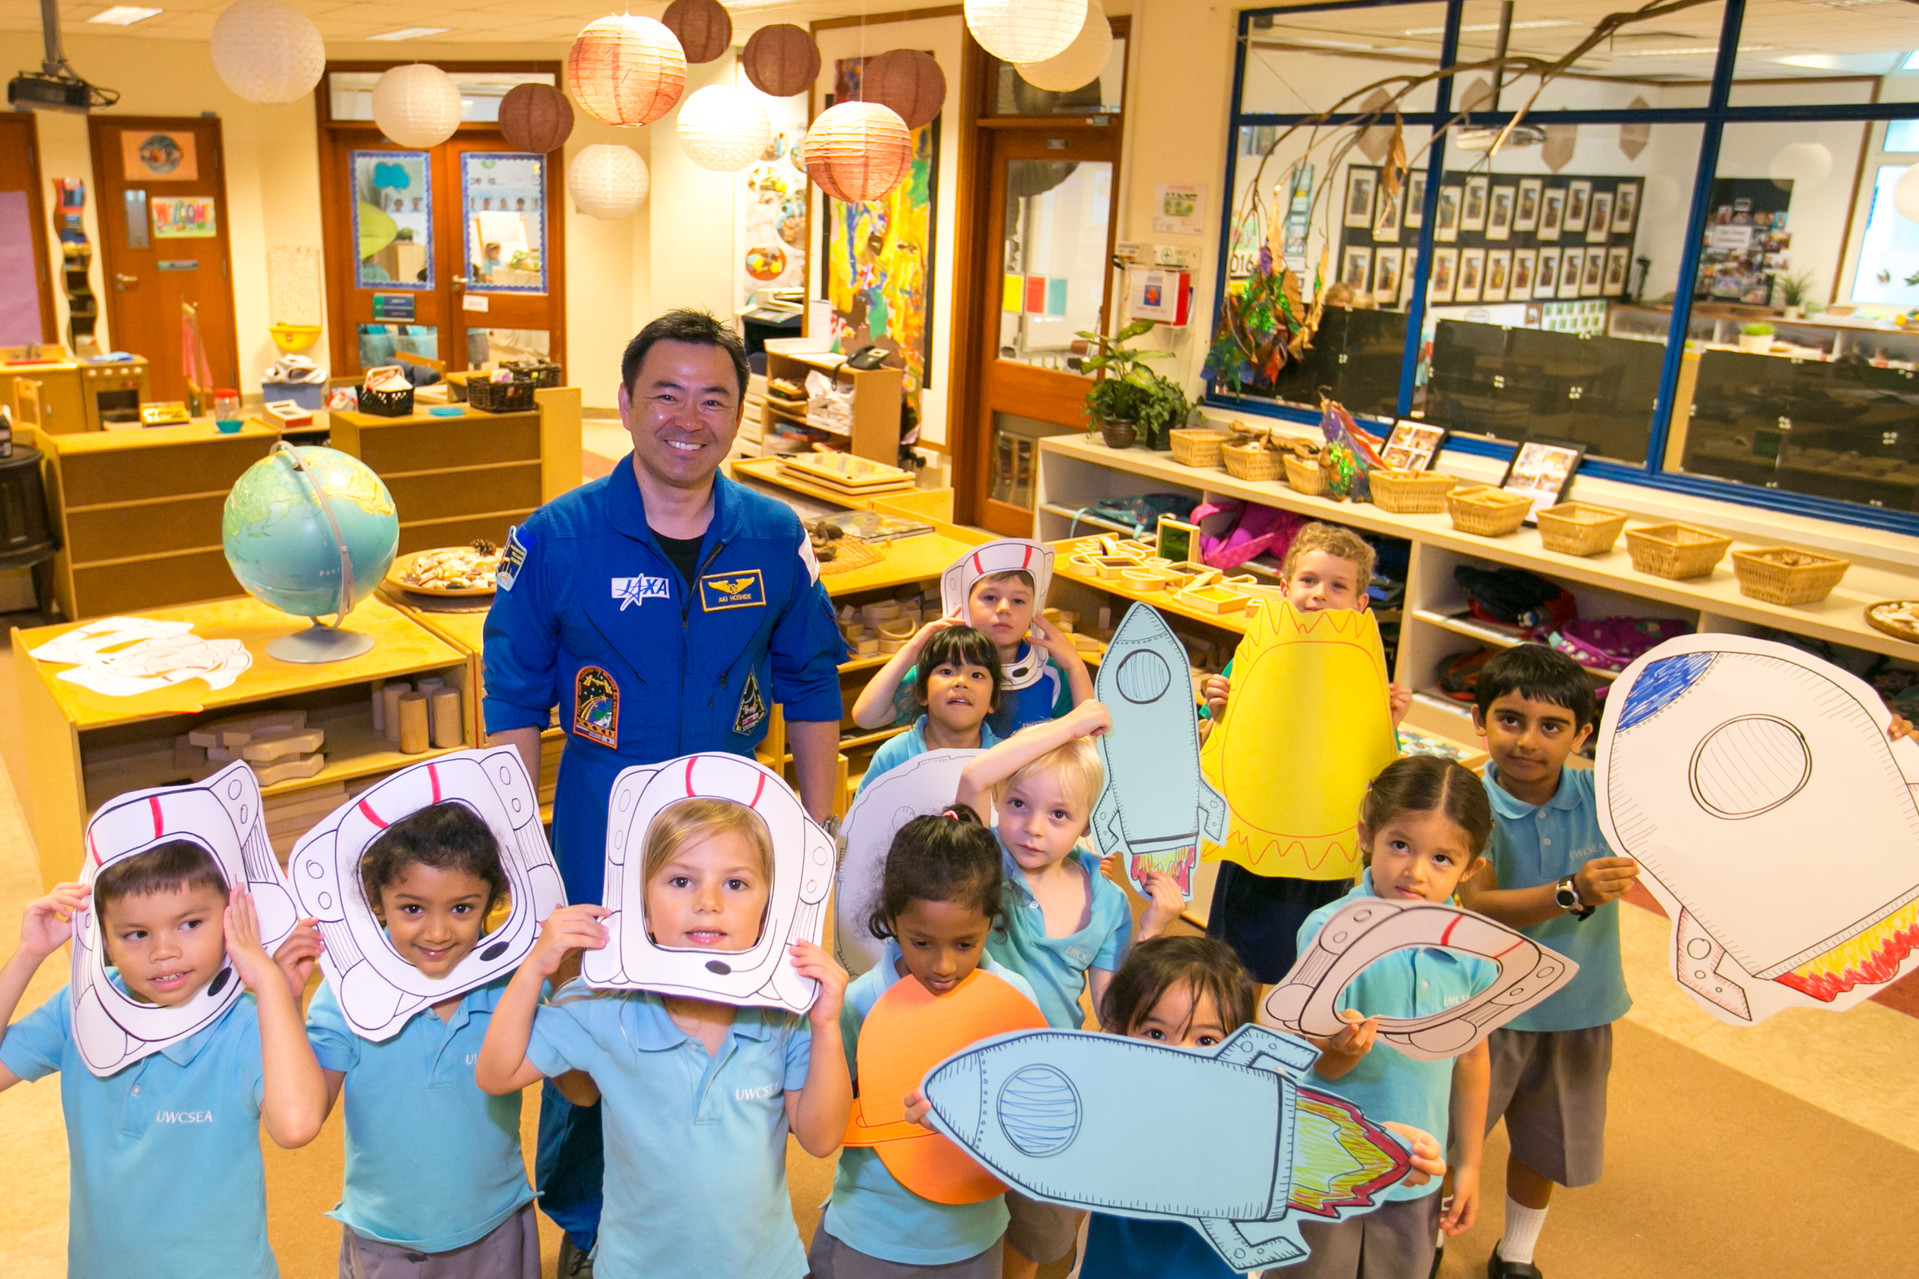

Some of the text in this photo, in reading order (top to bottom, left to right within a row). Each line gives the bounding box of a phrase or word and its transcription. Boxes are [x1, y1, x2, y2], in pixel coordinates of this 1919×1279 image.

[154, 201, 212, 224] WELCOME
[616, 575, 668, 605] JAXA
[155, 1110, 214, 1124] UWCSEA
